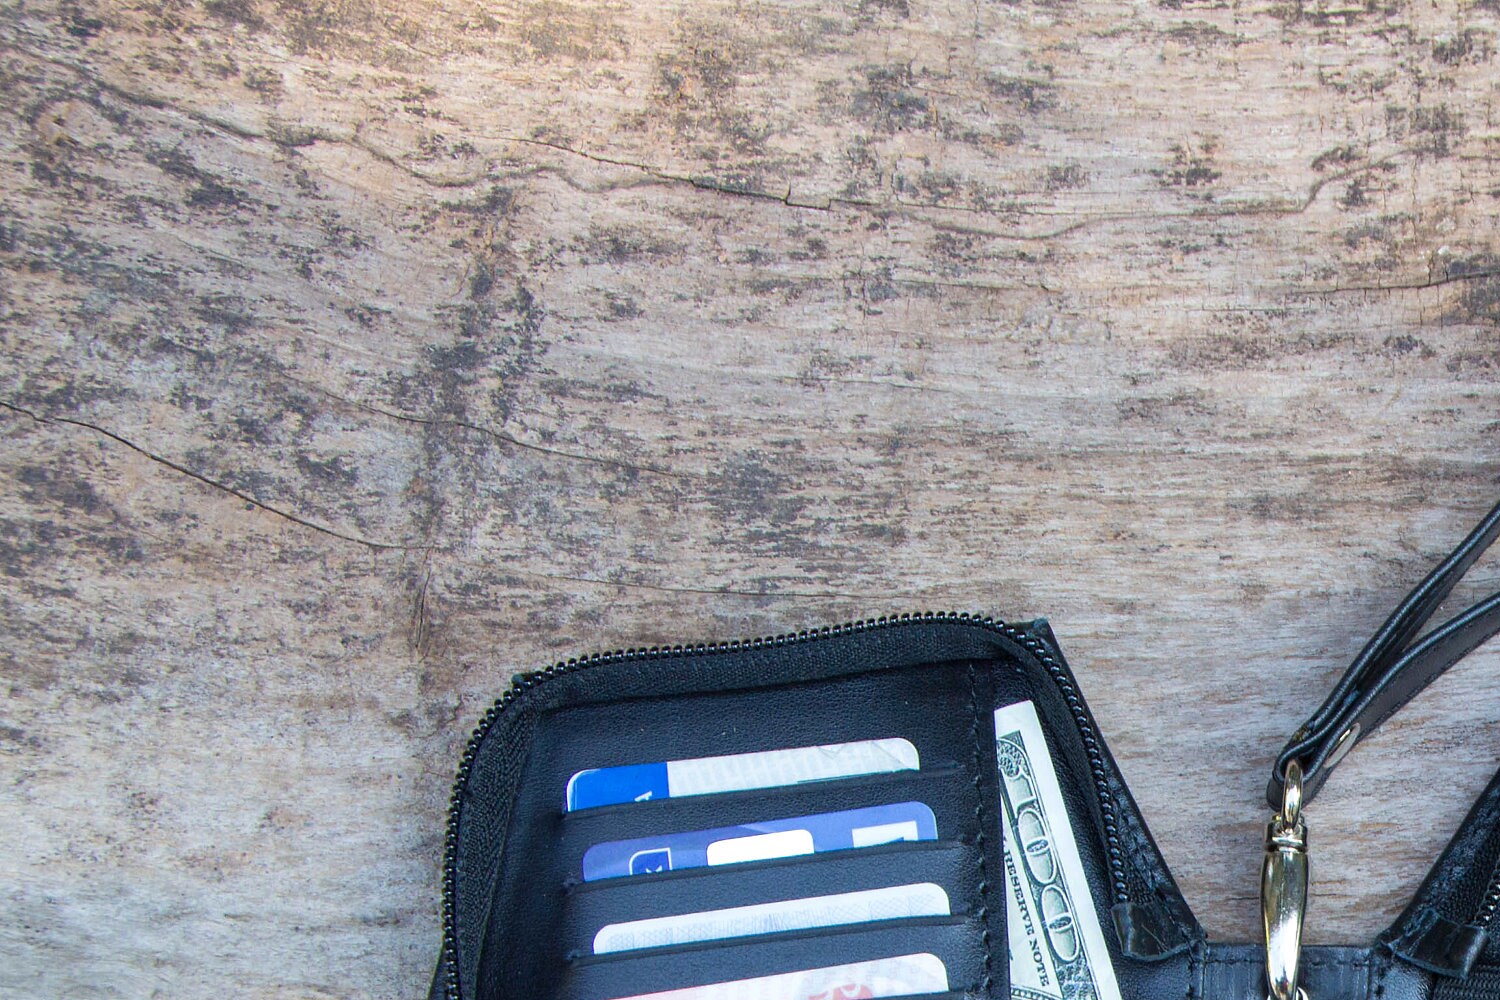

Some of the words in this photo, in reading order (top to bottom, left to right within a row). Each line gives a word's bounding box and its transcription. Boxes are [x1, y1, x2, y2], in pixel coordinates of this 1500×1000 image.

[1001, 768, 1080, 963] 100
[1003, 850, 1034, 936] RESERVE
[1028, 938, 1050, 987] NOTE
